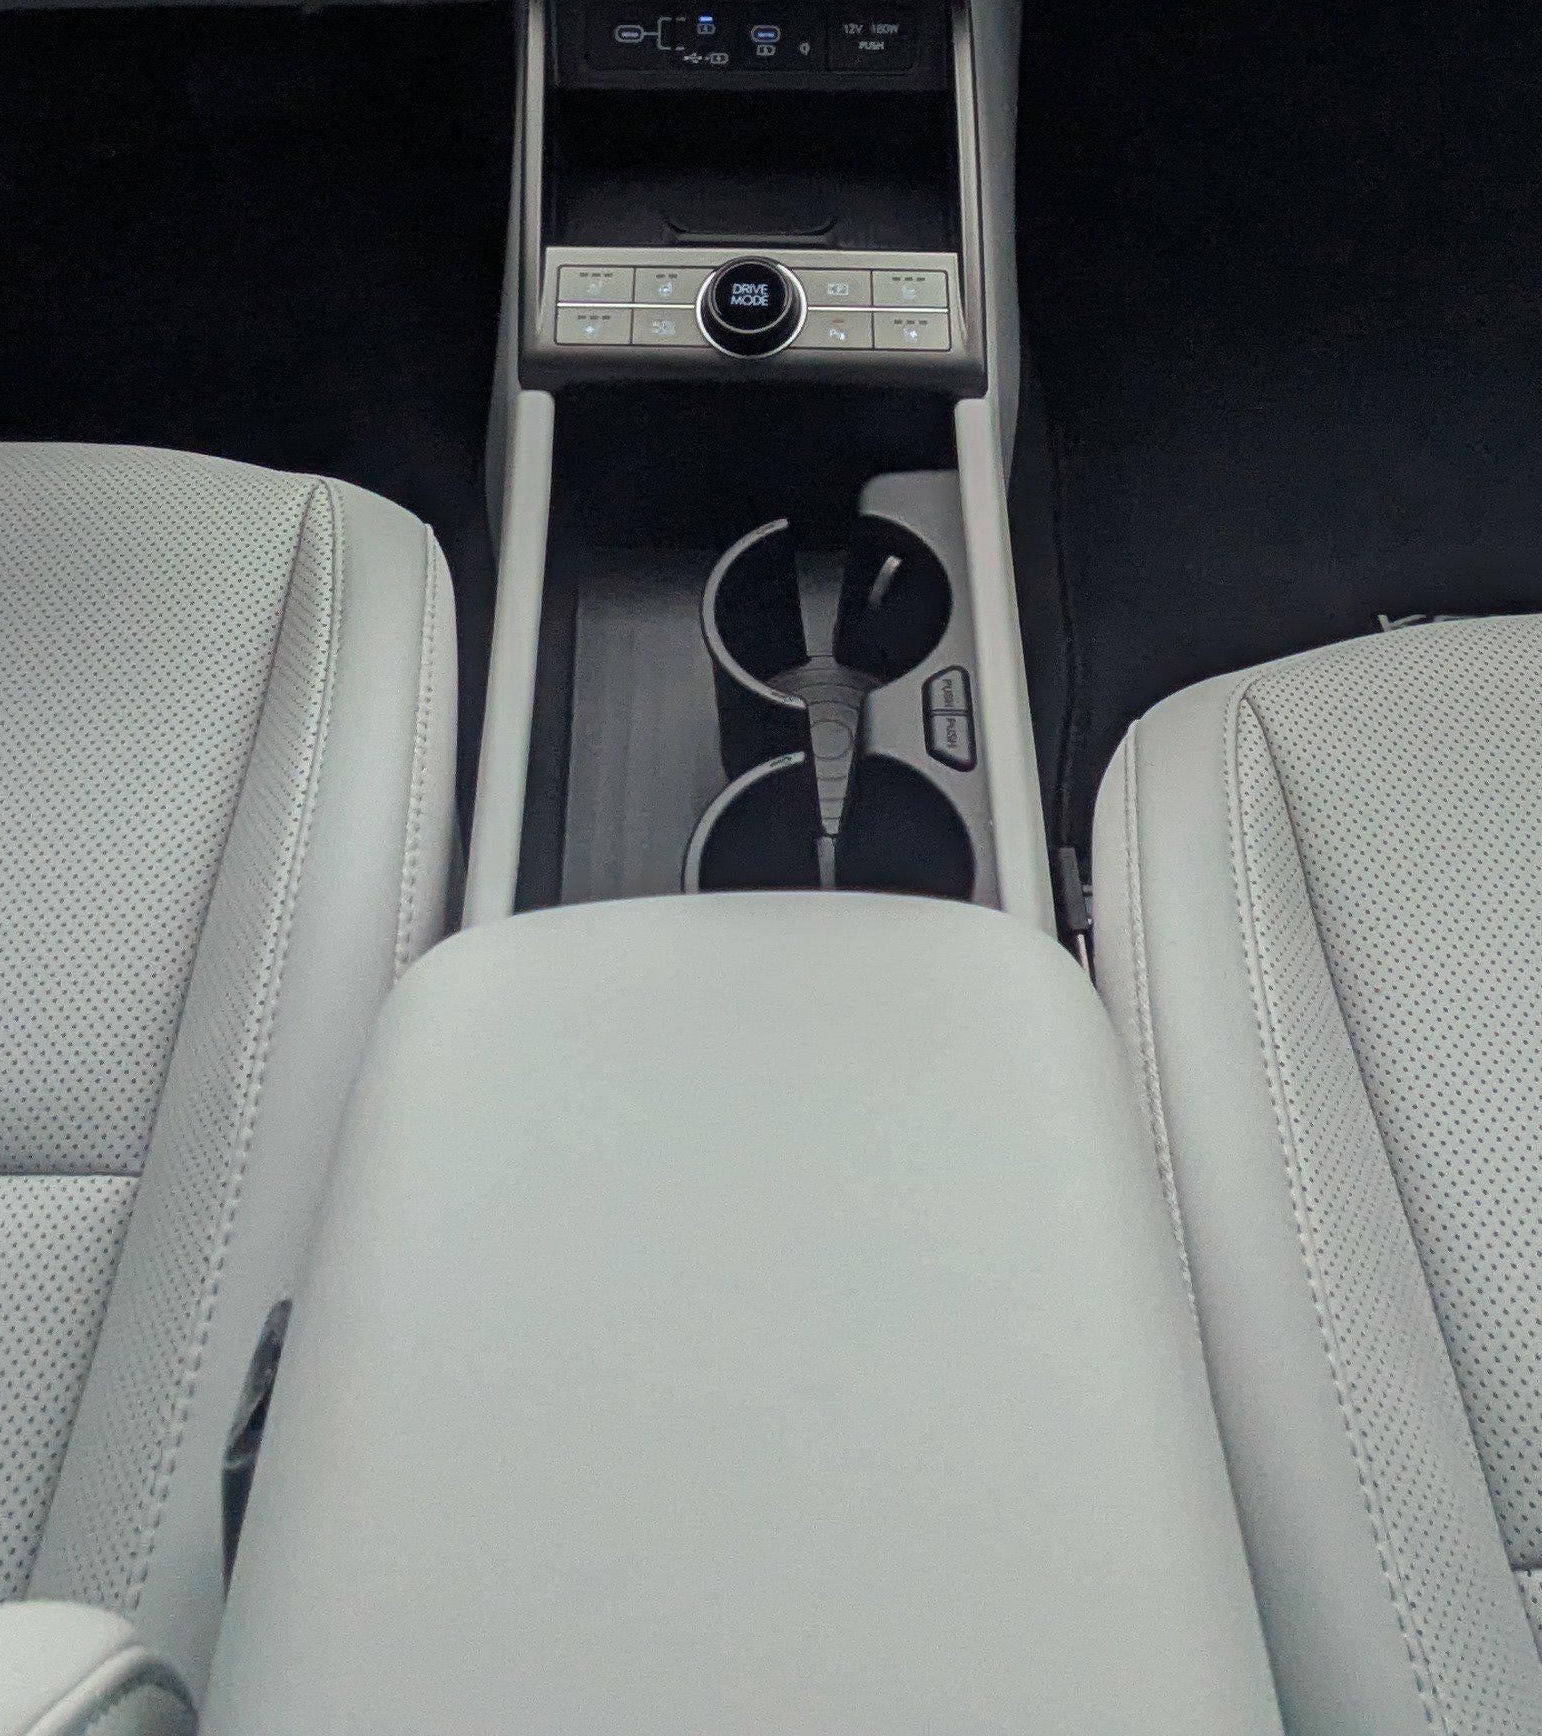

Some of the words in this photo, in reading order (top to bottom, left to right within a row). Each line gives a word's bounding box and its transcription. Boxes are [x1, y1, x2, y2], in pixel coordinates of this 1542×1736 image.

[858, 41, 885, 50] PUSH
[732, 282, 769, 295] DRIVE
[730, 294, 769, 307] MODE
[941, 678, 954, 707] PUSH
[946, 717, 958, 749] PUSH
